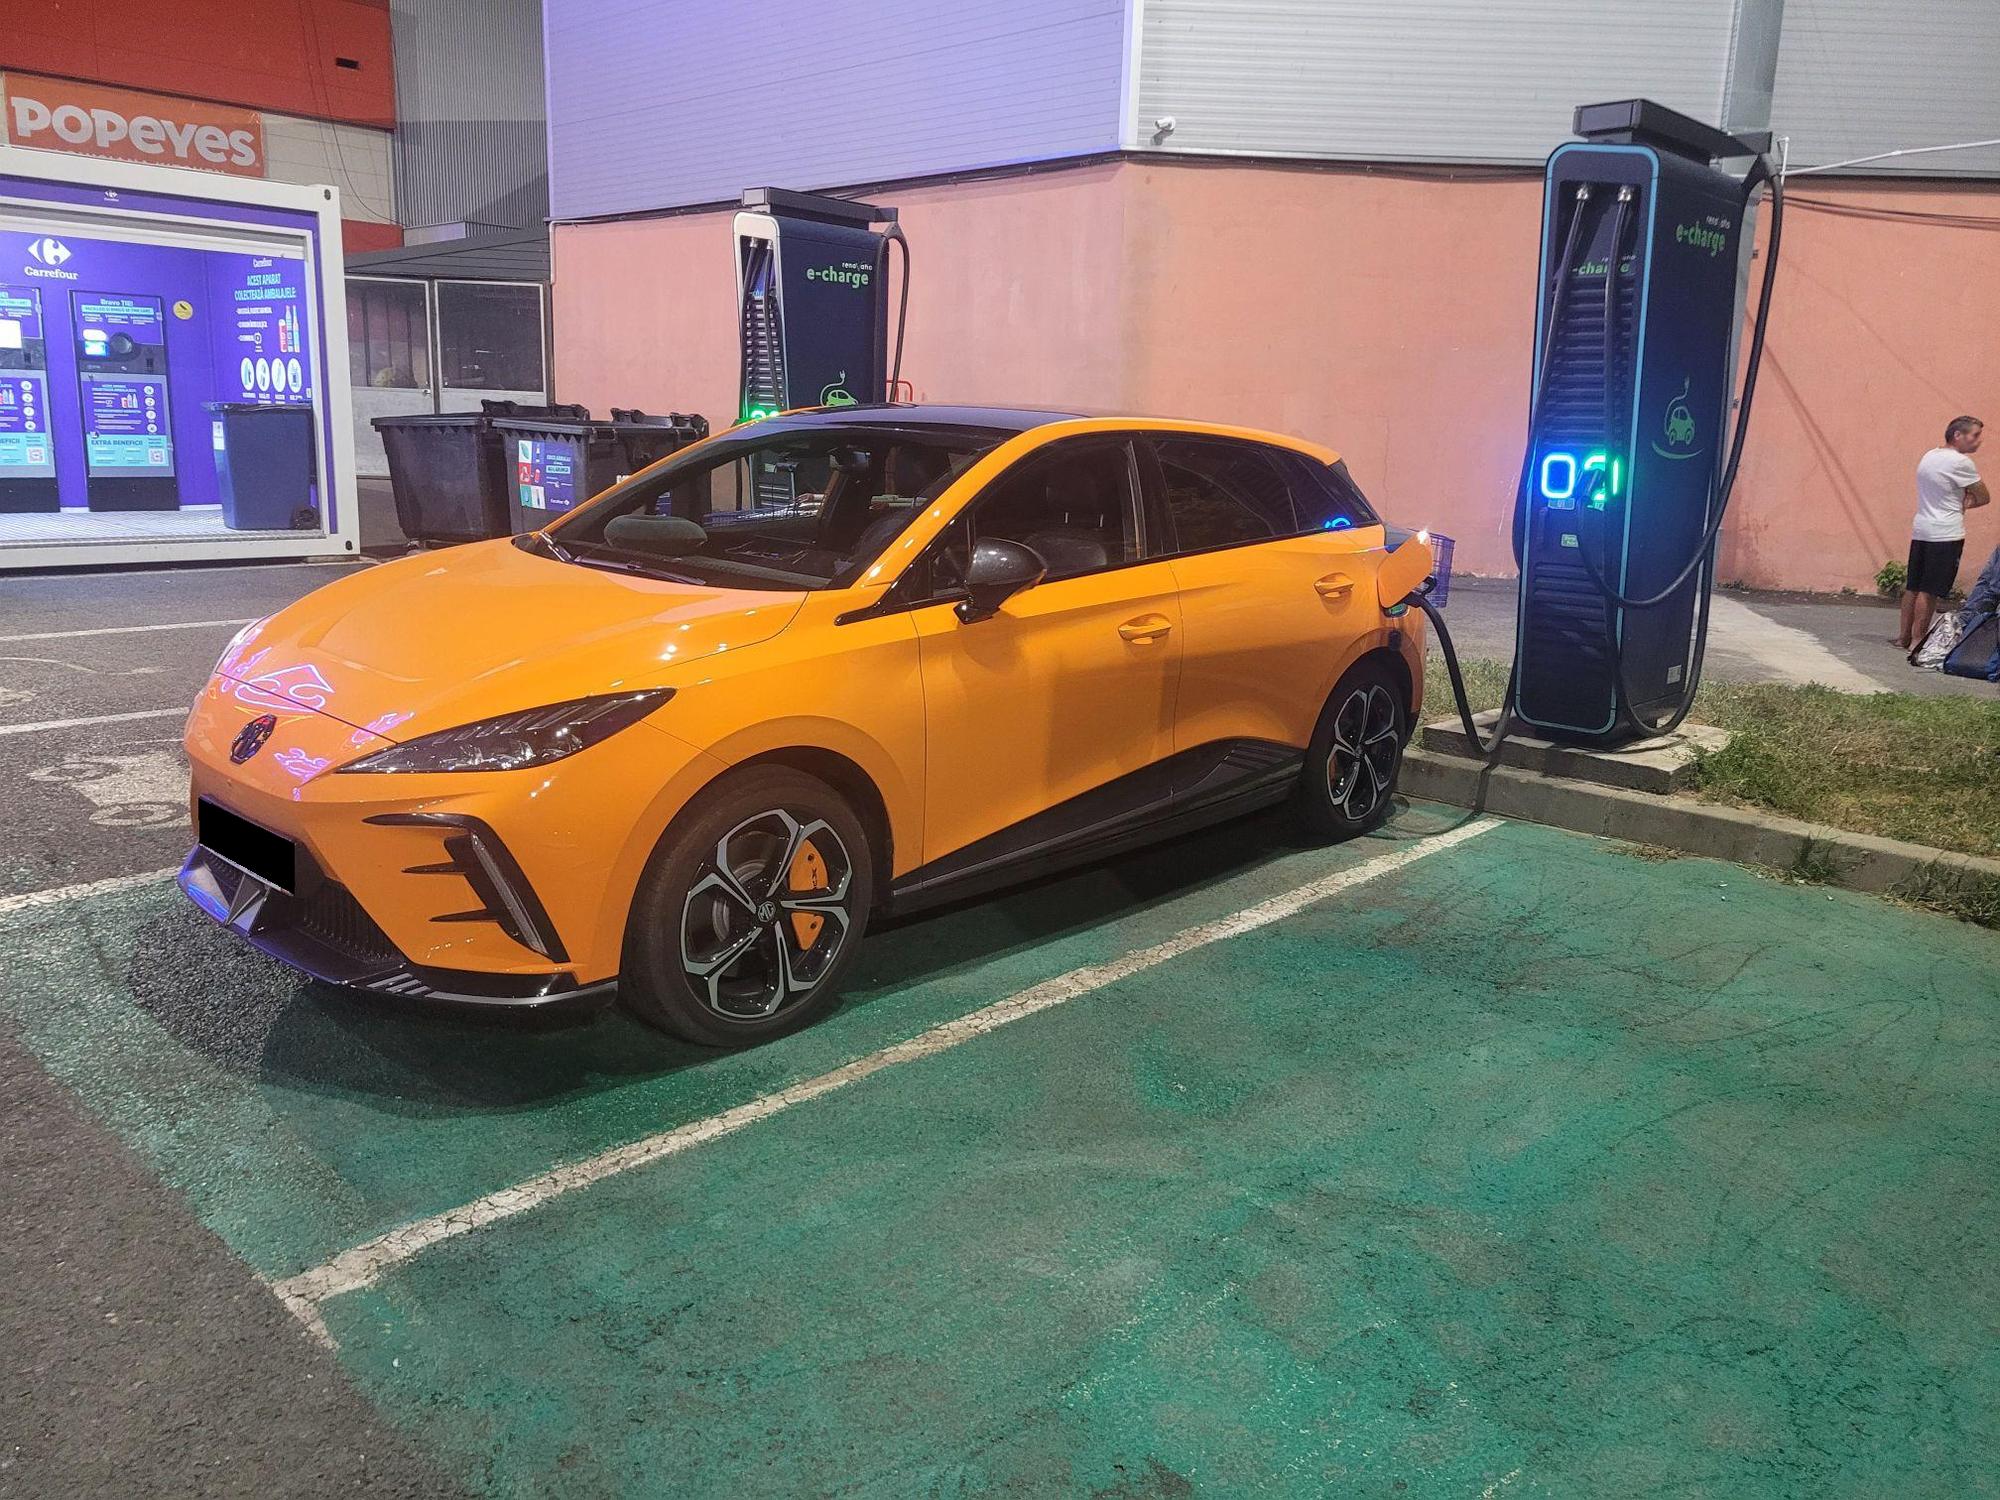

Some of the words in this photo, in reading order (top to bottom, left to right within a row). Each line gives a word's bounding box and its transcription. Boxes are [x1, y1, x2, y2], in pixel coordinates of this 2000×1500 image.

[11, 97, 256, 167] POPEYES
[1676, 220, 1726, 257] e-charge
[24, 266, 78, 280] Carrefour
[806, 265, 869, 289] e-charge
[759, 902, 775, 921] MG
